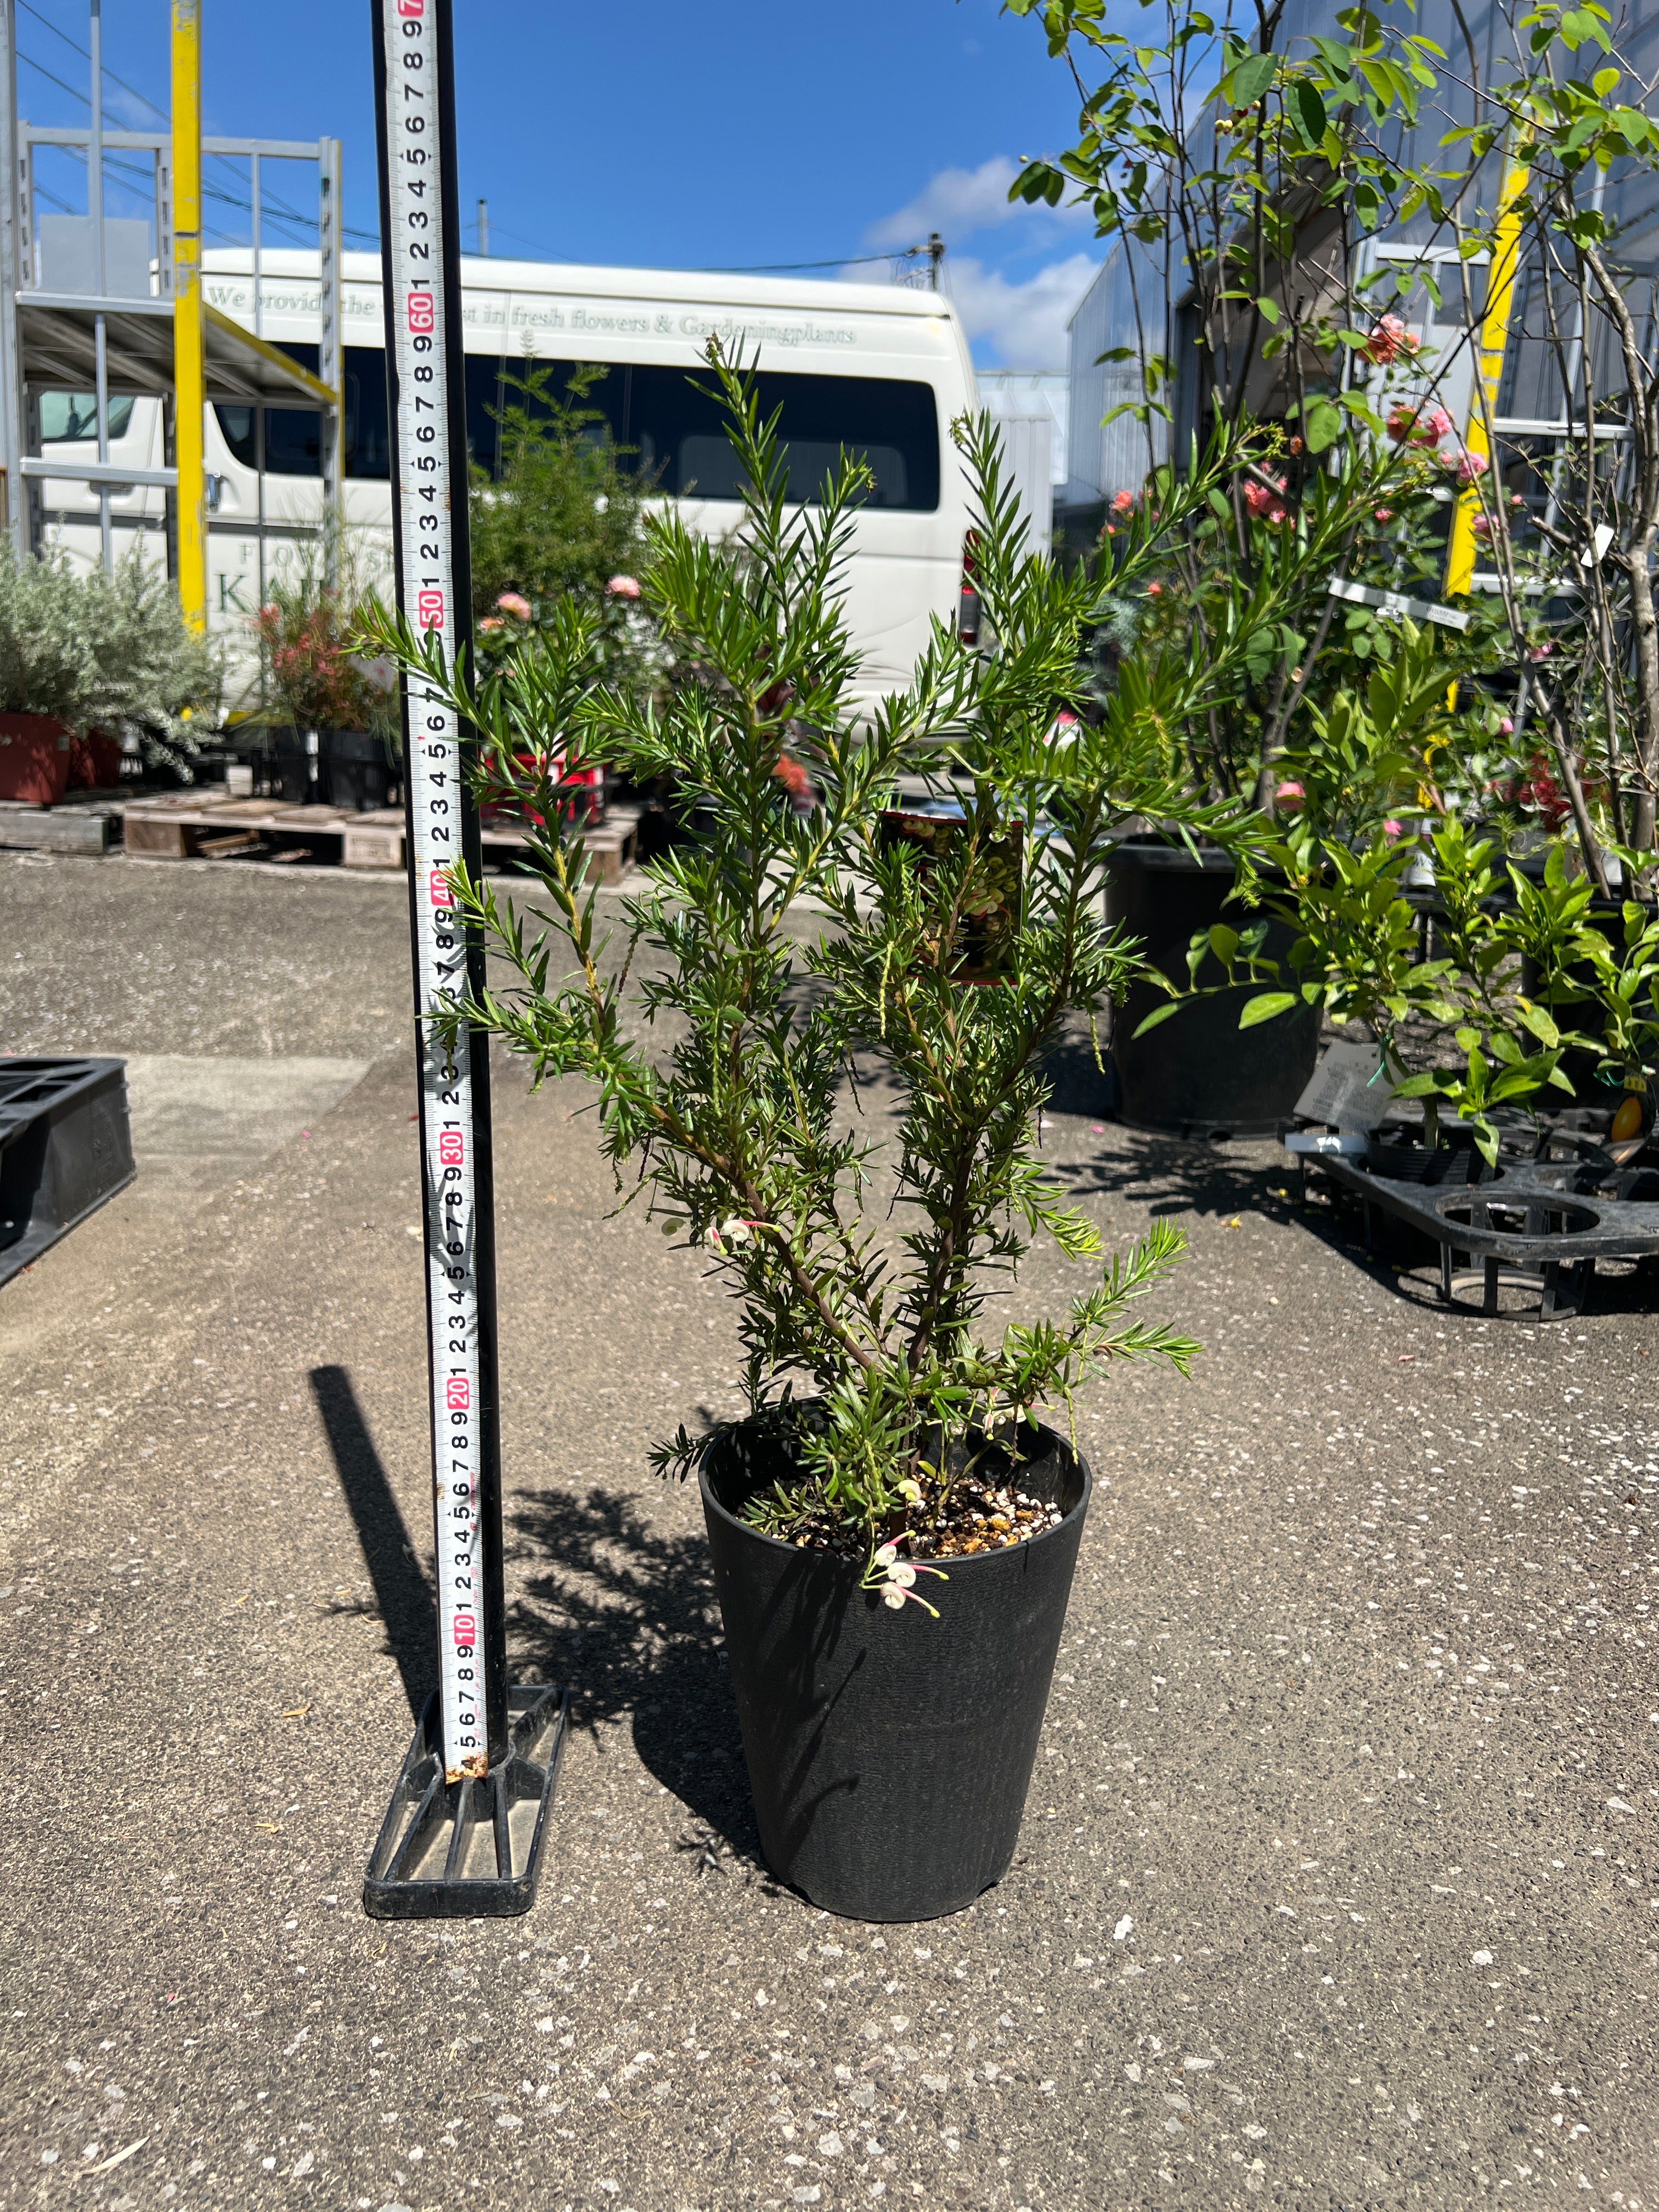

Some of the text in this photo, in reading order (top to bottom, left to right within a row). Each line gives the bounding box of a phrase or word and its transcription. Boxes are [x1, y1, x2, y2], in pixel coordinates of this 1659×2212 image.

[400, 0, 422, 11] 7
[403, 21, 422, 37] 9
[404, 53, 422, 69] 8
[405, 84, 423, 100] 7
[405, 117, 425, 133] 6
[407, 149, 425, 165] 5
[408, 180, 426, 198] 4
[409, 212, 428, 228] 3
[410, 243, 428, 259] 2
[411, 280, 430, 289] 1
[207, 287, 246, 307] We
[251, 292, 323, 313] provid
[340, 295, 376, 315] the
[484, 303, 505, 324] in
[511, 306, 565, 328] fresh
[571, 309, 651, 332] flowers
[653, 314, 674, 334] &
[410, 297, 432, 329] 60
[413, 336, 432, 352] 9
[414, 366, 433, 383] 8
[416, 397, 434, 412] 7
[417, 426, 435, 442] 6
[418, 456, 436, 472] 5
[419, 486, 437, 502] 4
[420, 515, 438, 531] 3
[421, 544, 438, 559] 2
[422, 578, 439, 587] 1
[421, 595, 442, 624] 50
[426, 687, 443, 702] 7
[427, 716, 445, 731] 6
[428, 744, 446, 759] 5
[430, 772, 447, 787] 4
[431, 799, 448, 814] 3
[432, 827, 449, 842] 2
[433, 859, 450, 867] 1
[432, 874, 452, 901] 40
[435, 908, 453, 923] 9
[437, 934, 454, 950] 8
[438, 961, 454, 976] 7
[441, 1065, 459, 1080] 3
[442, 1091, 459, 1105] 2
[443, 1121, 460, 1129] 1
[442, 1135, 462, 1162] 30
[444, 1167, 461, 1181] 9
[445, 1192, 462, 1206] 8
[447, 1216, 463, 1231] 7
[447, 1242, 464, 1255] 6
[448, 1266, 465, 1280] 5
[448, 1291, 465, 1305] 4
[449, 1316, 466, 1329] 3
[449, 1340, 466, 1352] 2
[448, 1381, 468, 1405] 20
[452, 1412, 467, 1425] 9
[452, 1436, 469, 1448] 8
[453, 1459, 469, 1472] 7
[453, 1483, 470, 1496] 6
[454, 1507, 470, 1519] 5
[454, 1530, 470, 1543] 4
[455, 1554, 471, 1566] 3
[455, 1577, 471, 1589] 2
[455, 1618, 474, 1640] 10
[458, 1645, 473, 1657] 9
[458, 1668, 473, 1680] 8
[459, 1691, 474, 1703] 7
[460, 1713, 475, 1725] 6
[461, 1736, 476, 1748] 5
